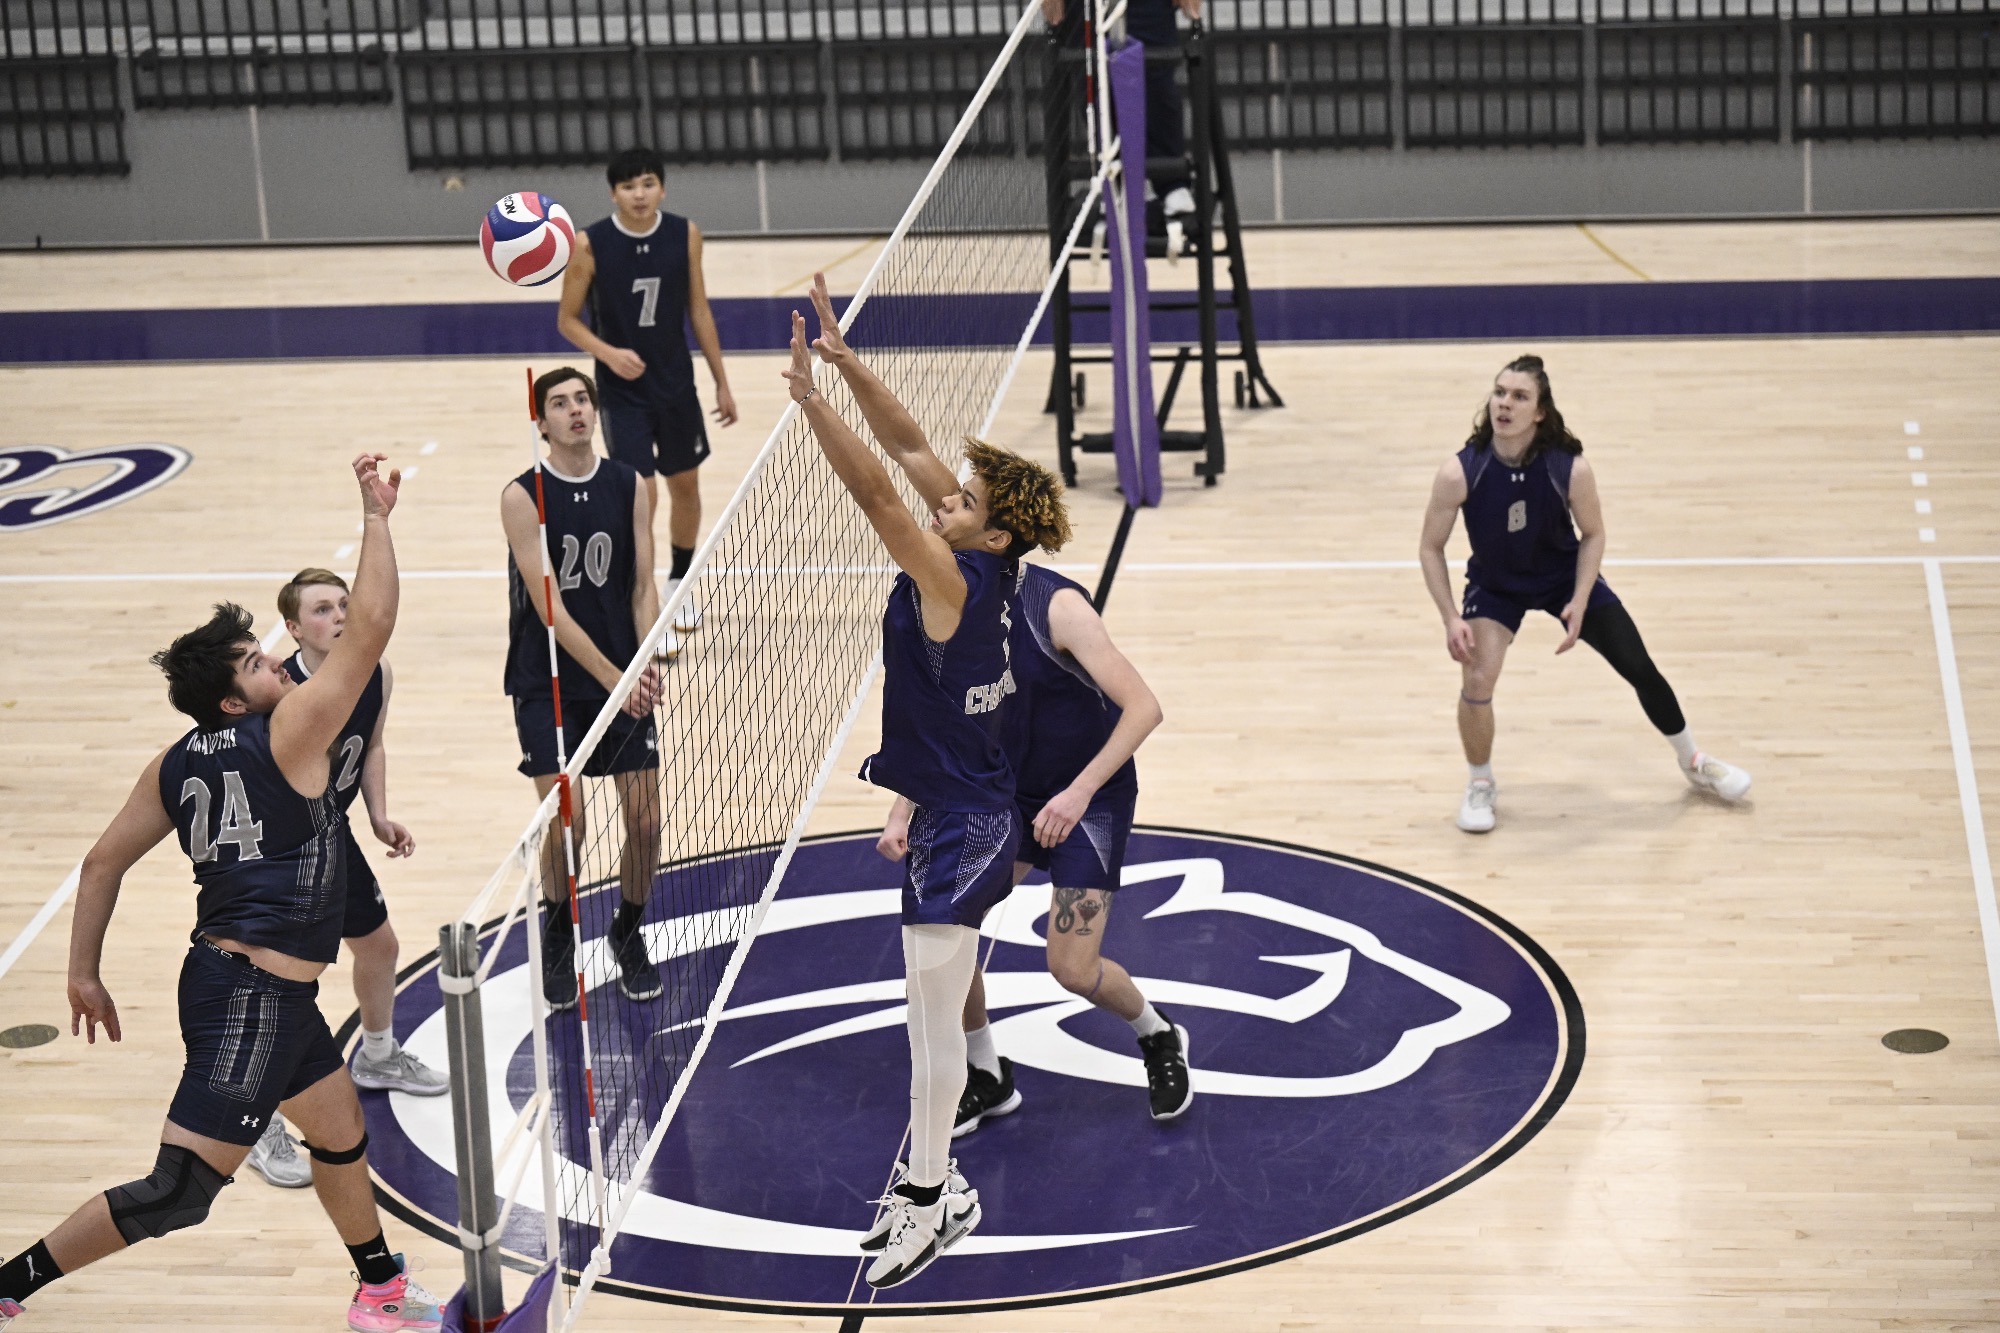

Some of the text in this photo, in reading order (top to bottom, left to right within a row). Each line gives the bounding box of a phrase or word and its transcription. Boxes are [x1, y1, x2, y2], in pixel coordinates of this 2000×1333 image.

[632, 277, 661, 327] 7
[560, 531, 612, 592] 20
[180, 771, 264, 863] 24
